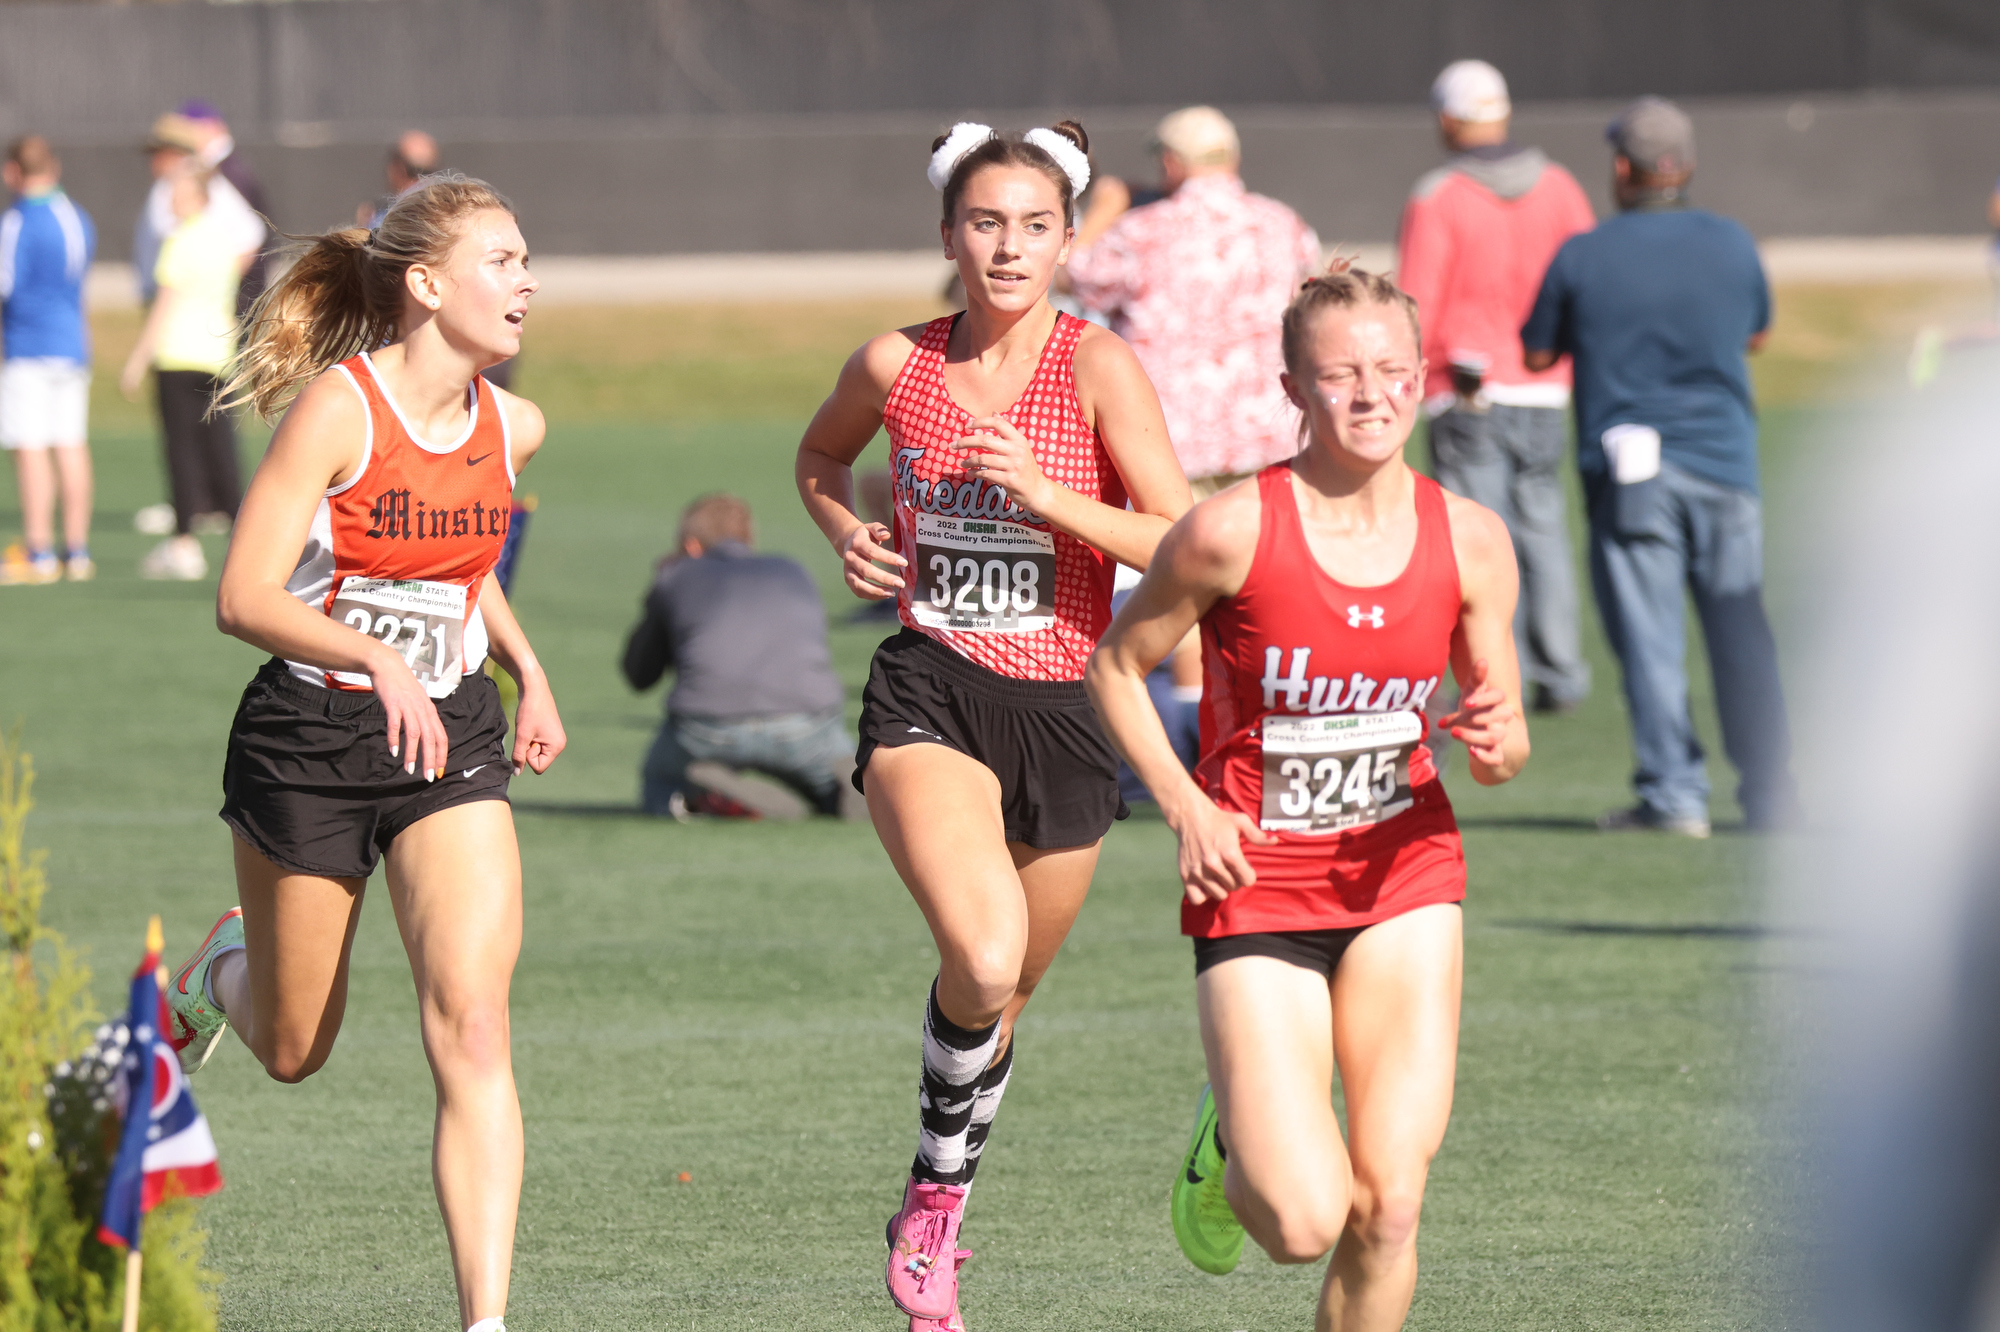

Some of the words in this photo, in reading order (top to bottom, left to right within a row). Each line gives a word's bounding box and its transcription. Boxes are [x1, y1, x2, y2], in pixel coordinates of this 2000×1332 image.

[365, 487, 509, 541] Minster
[918, 528, 942, 538] Cross
[943, 531, 978, 545] Country
[980, 535, 1052, 549] Championships
[937, 520, 957, 530] 2022
[963, 521, 997, 534] OHSAA
[1001, 526, 1031, 537] STATE
[392, 580, 424, 594] OHSAA
[425, 586, 450, 597] STATE
[929, 553, 1039, 613] 3208
[369, 587, 405, 602] Country
[407, 595, 463, 611] Championships
[1260, 645, 1438, 714] Huron
[1266, 733, 1296, 742] Cross
[1299, 731, 1340, 743] Country
[1343, 725, 1417, 741] Championships
[1291, 722, 1315, 731] 2022
[1323, 717, 1359, 731] OHSAA
[1279, 749, 1401, 816] 3245
